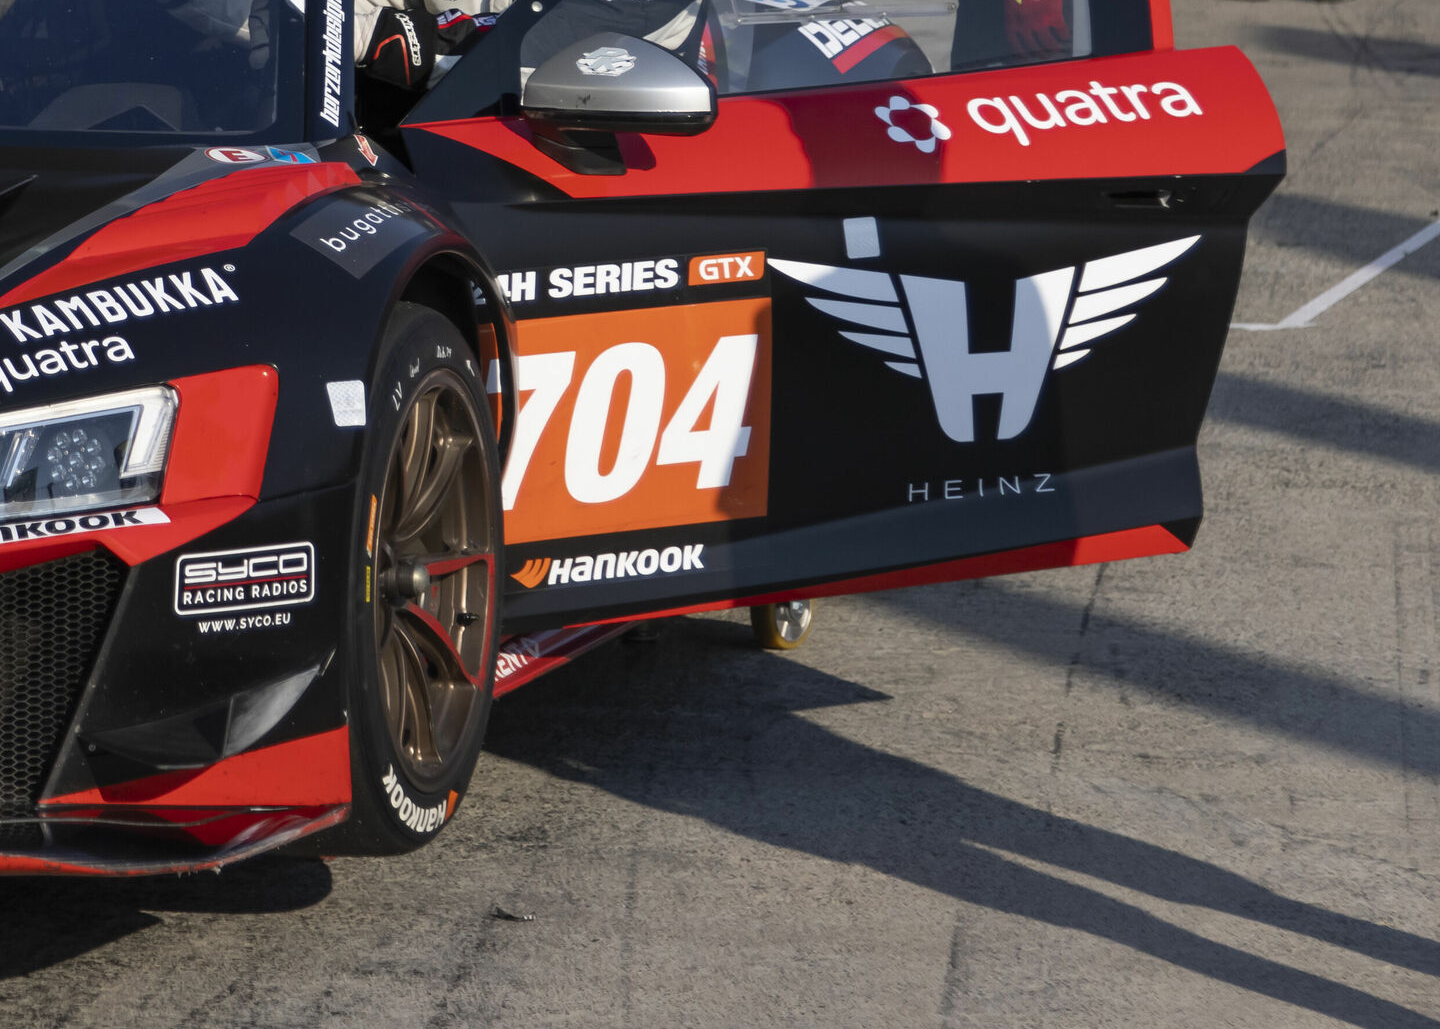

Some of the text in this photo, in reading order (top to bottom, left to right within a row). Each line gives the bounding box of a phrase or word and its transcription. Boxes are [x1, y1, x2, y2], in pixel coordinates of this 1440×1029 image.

[966, 80, 1203, 147] quatra
[548, 258, 680, 299] SERIES
[698, 256, 755, 281] GTX
[486, 333, 759, 512] 704
[908, 473, 1056, 502] HEINZ
[184, 552, 308, 584] SYCO
[182, 579, 308, 605] RACING RADIOS
[198, 612, 292, 634] WWW.SYCO.EU
